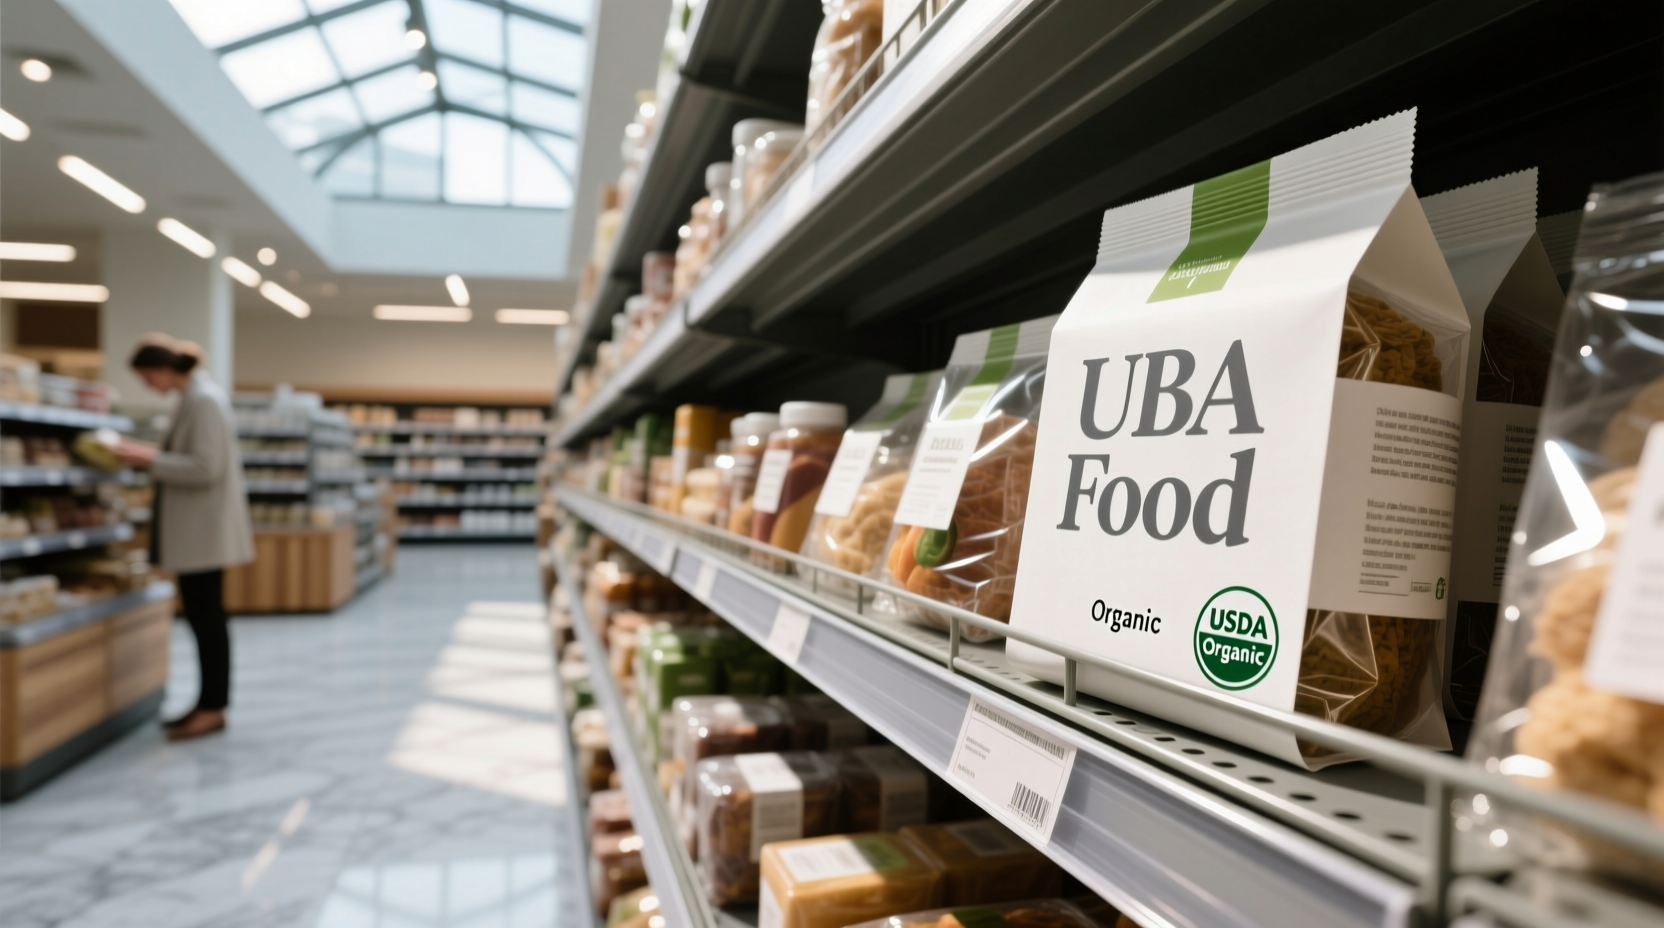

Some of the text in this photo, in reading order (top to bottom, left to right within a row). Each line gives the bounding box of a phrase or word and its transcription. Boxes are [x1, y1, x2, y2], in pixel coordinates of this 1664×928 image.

[1080, 339, 1265, 440] UBA
[1057, 448, 1256, 547] Food
[1091, 599, 1162, 635] Organic
[1209, 607, 1268, 640] USDA
[1202, 637, 1265, 667] Organic
